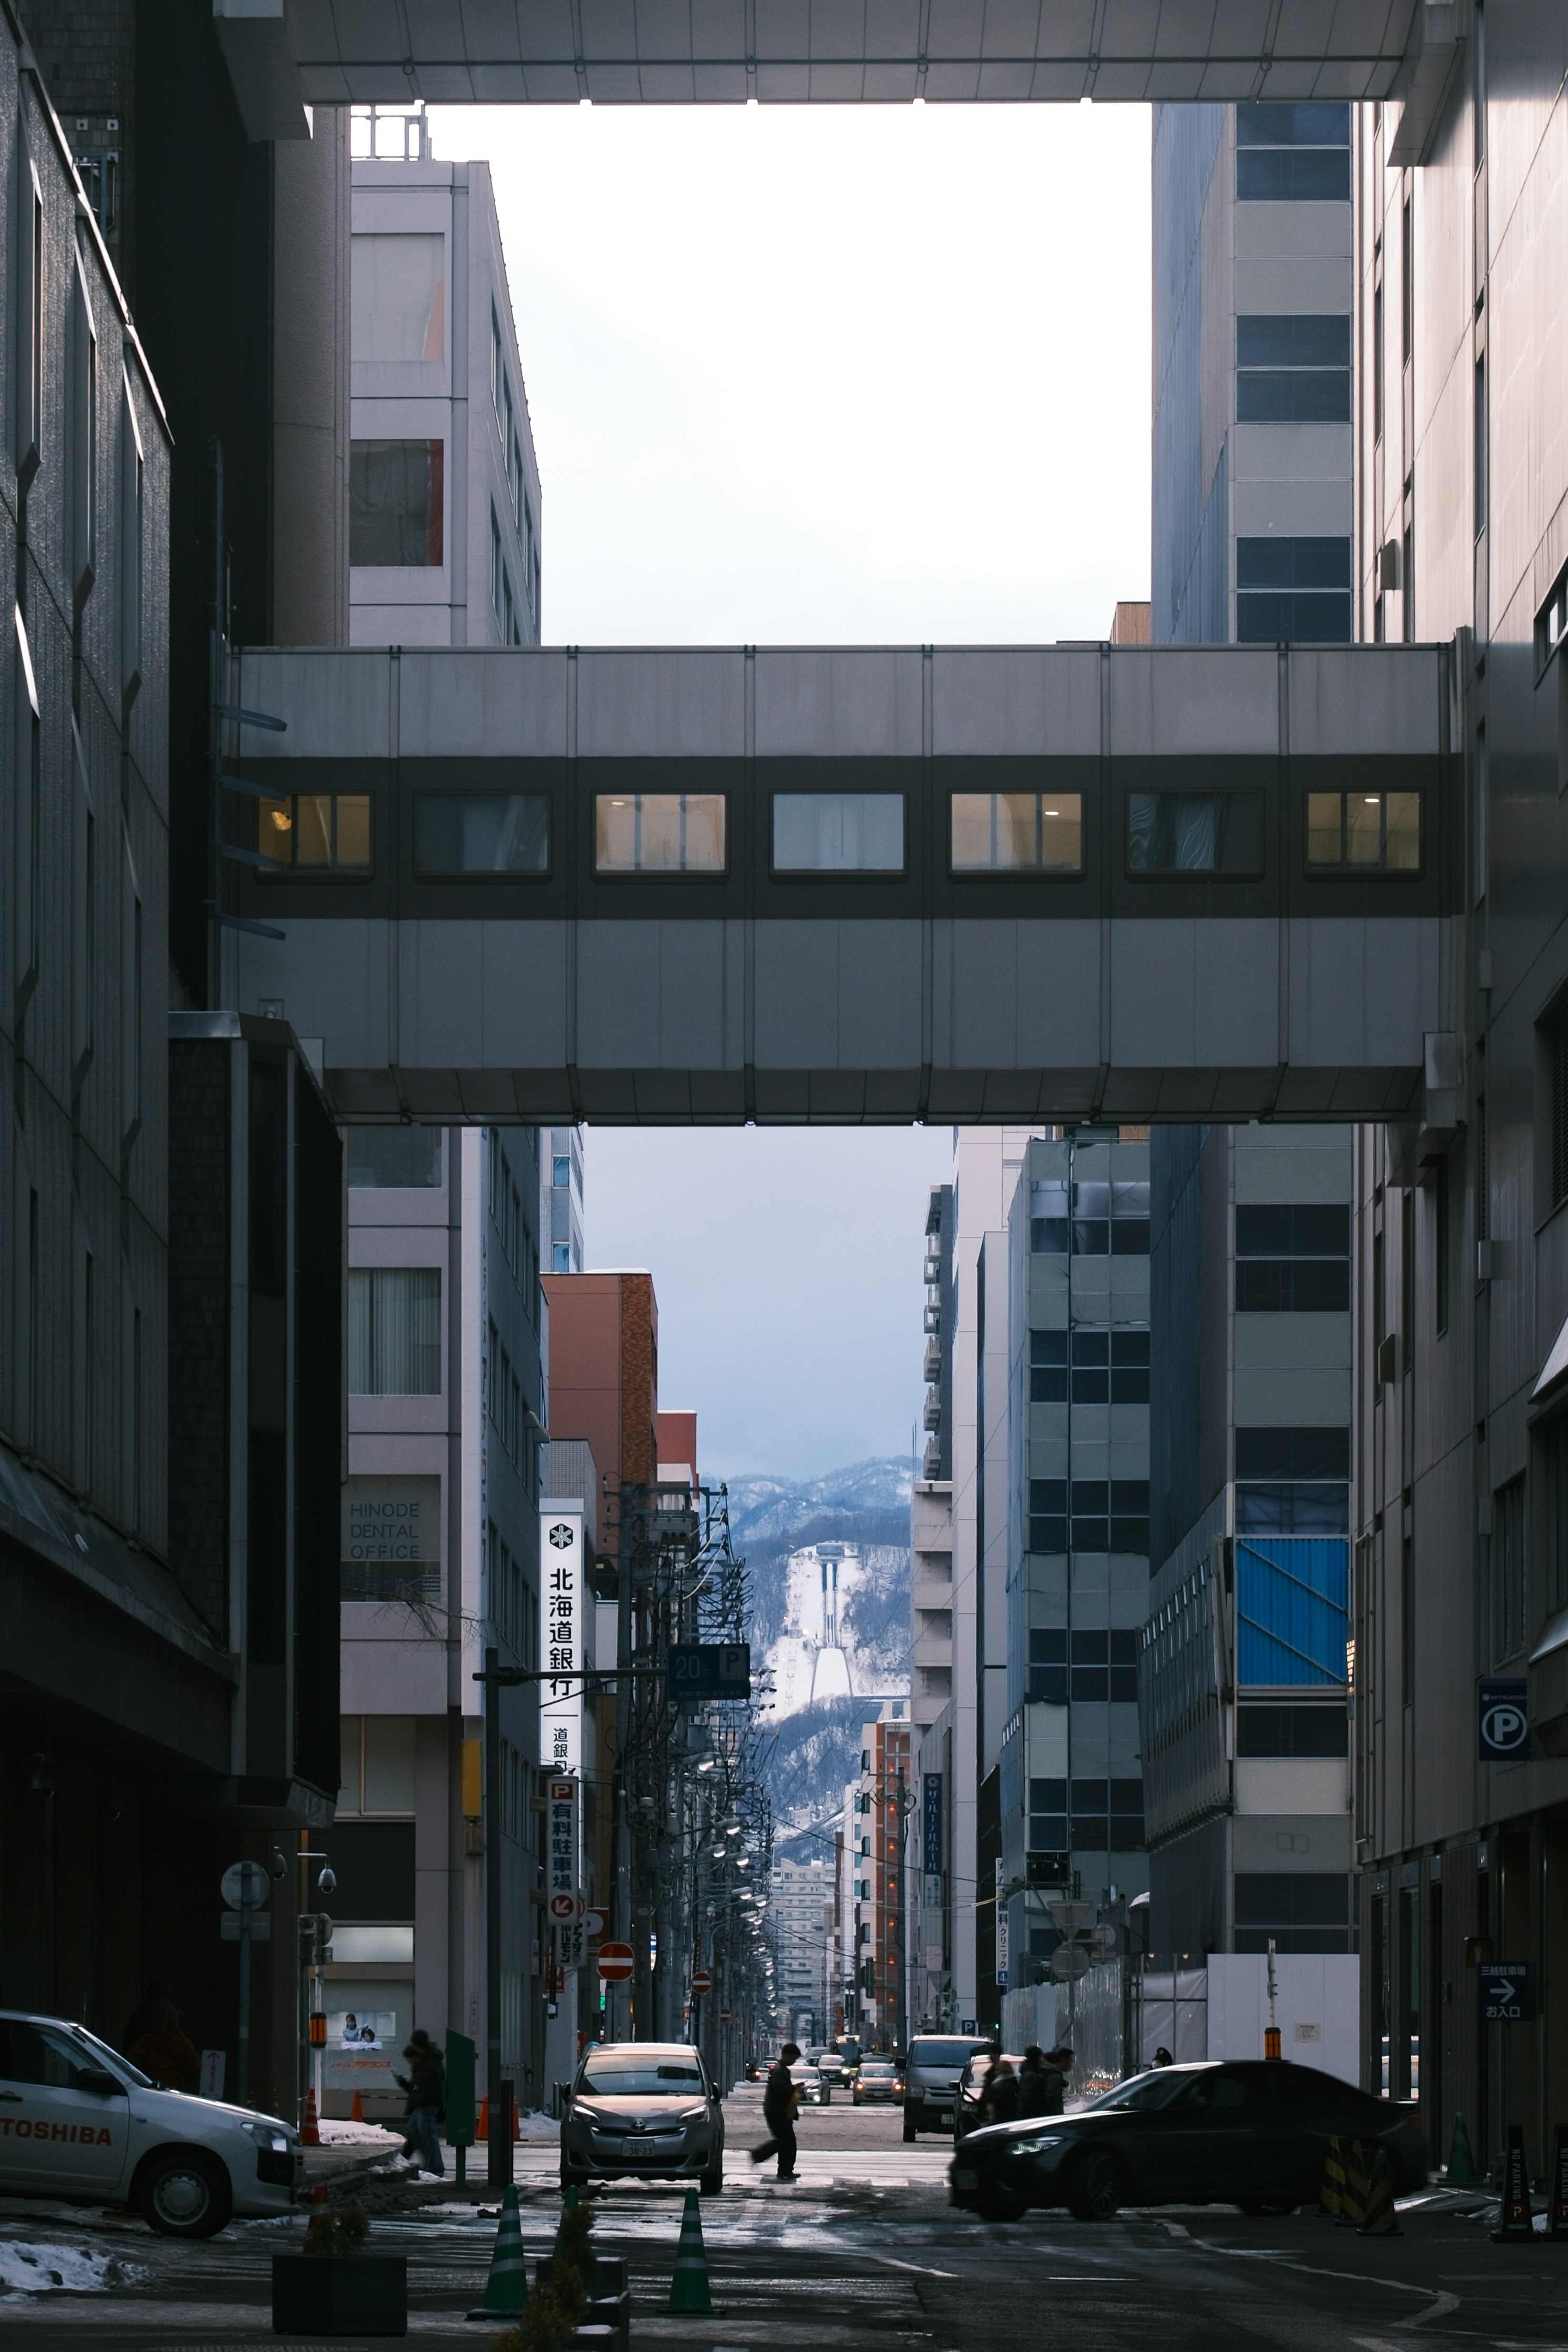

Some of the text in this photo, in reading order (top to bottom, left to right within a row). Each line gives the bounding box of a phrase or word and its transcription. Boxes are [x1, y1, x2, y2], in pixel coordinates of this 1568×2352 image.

[351, 1503, 420, 1517] HINODE
[351, 1524, 419, 1538] DENTAL
[351, 1545, 420, 1559] OFFICE
[549, 1568, 573, 1696] 北海道銀行
[726, 1651, 739, 1672] P
[1494, 1712, 1519, 1742] P
[554, 1785, 570, 1798] P
[927, 1790, 939, 1871] ザ・ルーテルホール
[553, 1803, 572, 1891] 有料駐車場
[1486, 2006, 1520, 2018] お入口
[964, 2022, 973, 2032] P
[1, 2118, 113, 2147] TOSHIBA
[1512, 2148, 1522, 2200] NO PARKING
[1513, 2206, 1523, 2218] P
